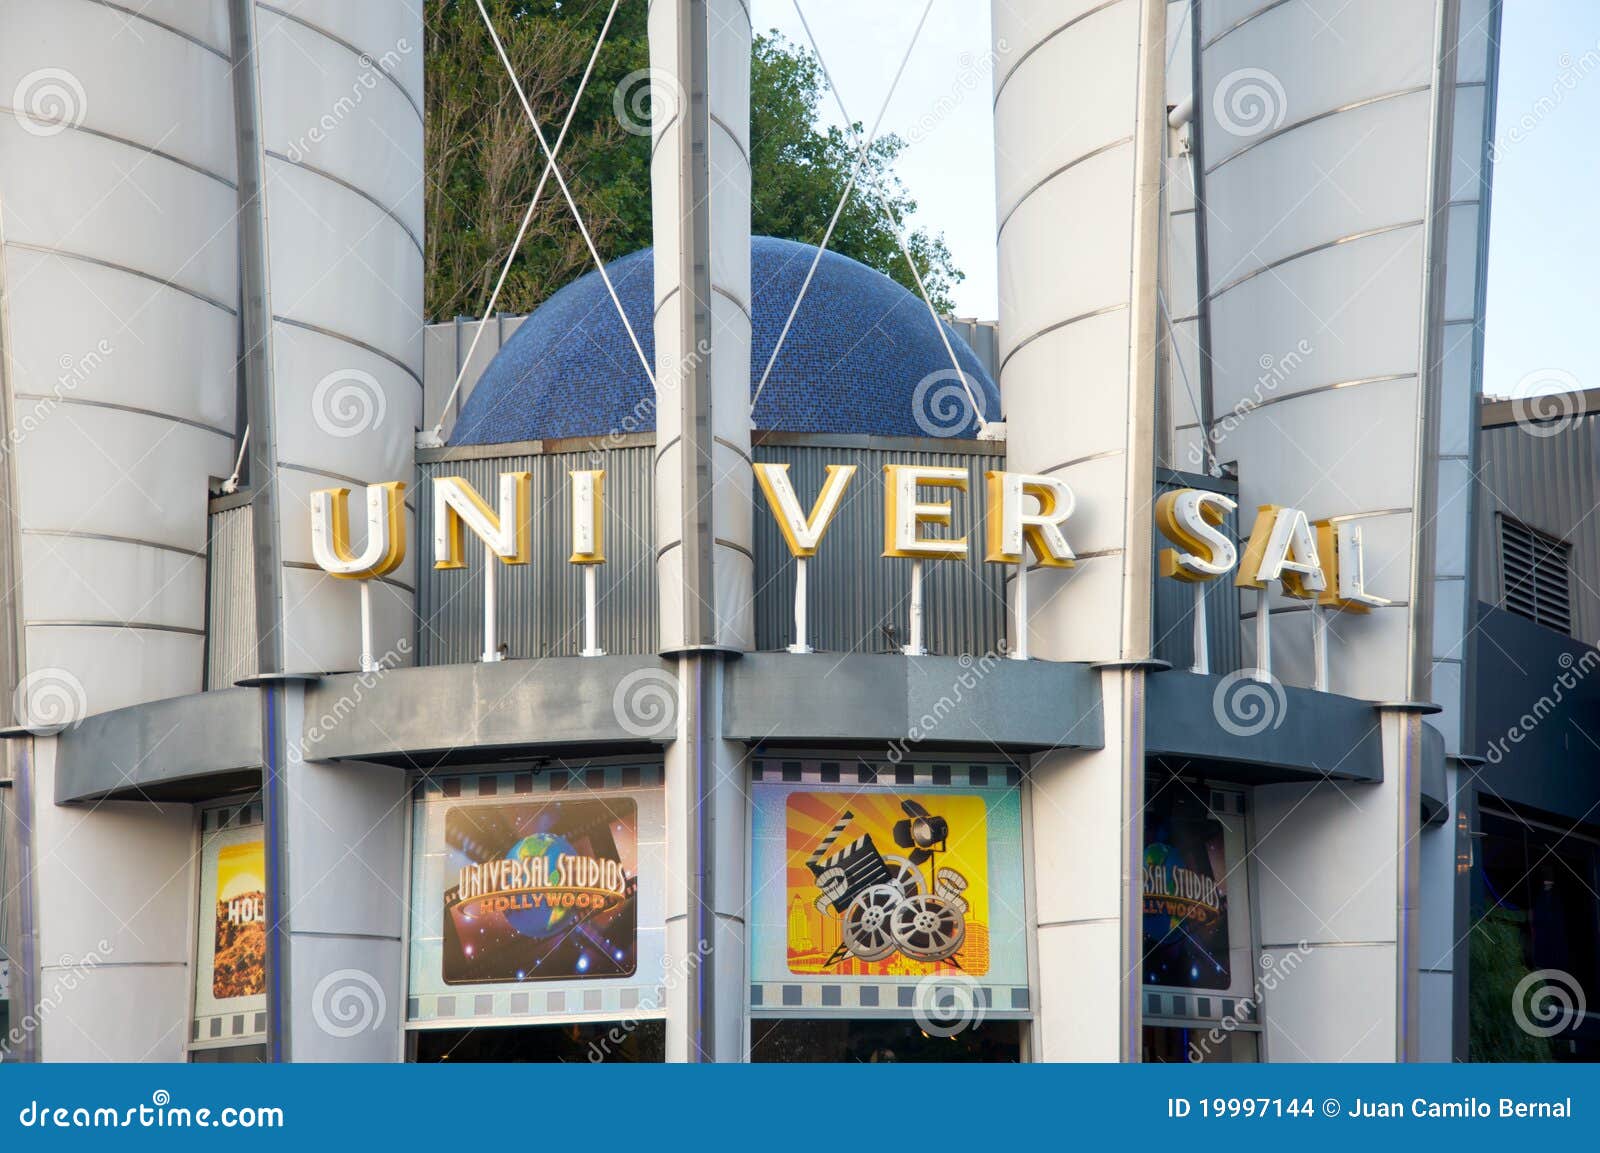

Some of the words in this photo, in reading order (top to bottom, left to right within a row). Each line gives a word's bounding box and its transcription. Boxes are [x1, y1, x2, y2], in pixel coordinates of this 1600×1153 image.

[310, 463, 1391, 614] UNIVERSAL
[458, 855, 554, 901] UNIVERSAL
[557, 853, 626, 895] STUDIOS
[1172, 864, 1220, 910] STUDIOS
[479, 892, 606, 915] HOLLYWOOD
